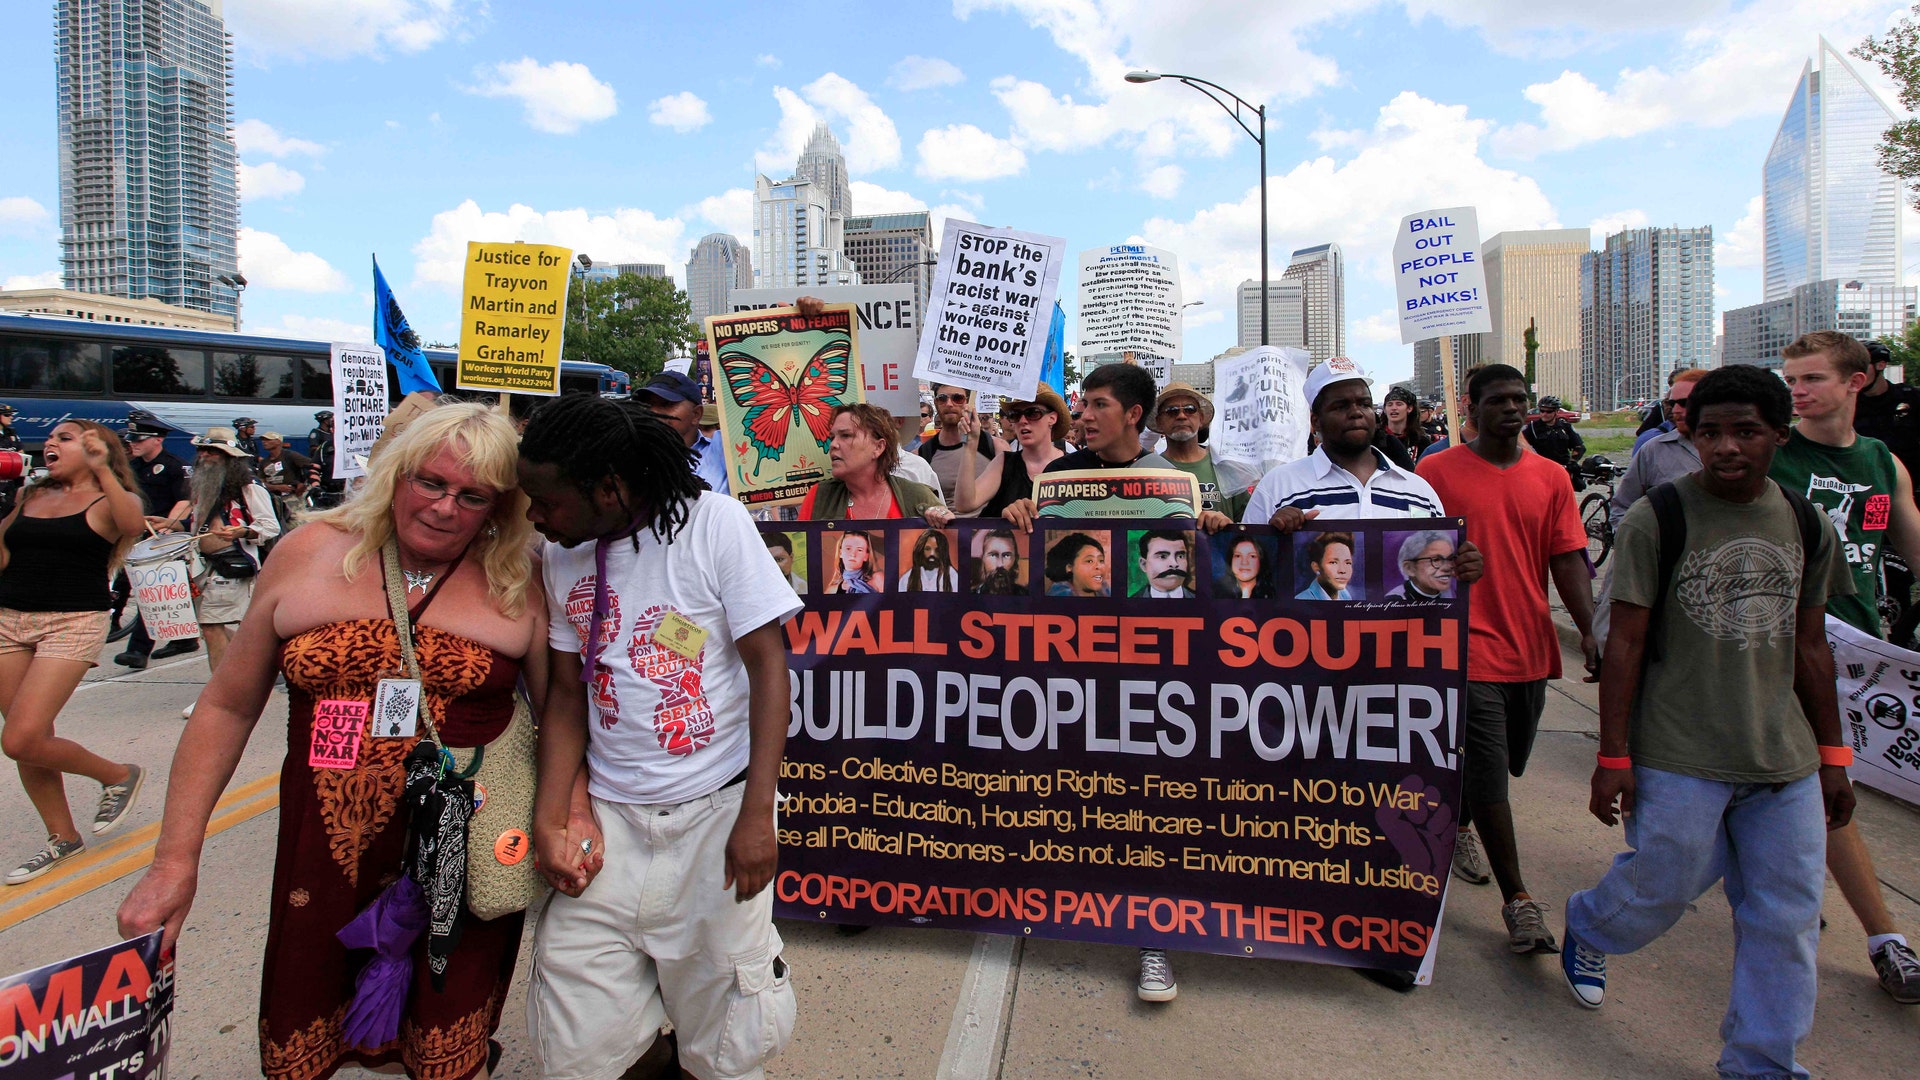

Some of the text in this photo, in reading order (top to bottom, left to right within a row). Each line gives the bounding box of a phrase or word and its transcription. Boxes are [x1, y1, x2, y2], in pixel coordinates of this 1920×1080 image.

[960, 234, 1043, 263] STOP the
[1110, 245, 1146, 254] PERMIT
[1415, 234, 1454, 250] OUT
[475, 249, 561, 266] Justice for
[1100, 255, 1151, 263] Amendment
[1401, 252, 1475, 274] PEOPLE
[956, 253, 1038, 287] bank's
[1419, 272, 1459, 288] NOT
[485, 273, 548, 293] Trayvon
[949, 281, 1040, 309] racist war
[1406, 287, 1478, 311] BANKS!
[470, 296, 557, 315] Martin and
[972, 303, 1030, 323] against
[475, 321, 550, 343] Ramarley
[715, 313, 849, 338] NO PAPERS NO FEAR!!!
[945, 311, 1026, 337] workers &
[939, 324, 1027, 357] the poor!
[1082, 336, 1128, 346] Government
[388, 349, 414, 368] FEAR
[477, 345, 544, 364] Graham!
[937, 346, 1021, 370] Coalition to March on
[465, 363, 552, 379] Workers World Party
[944, 357, 1012, 377] Wall Street South
[463, 375, 505, 386] workers.org
[1040, 481, 1190, 499] NO PAPERS NO FEAR!!!
[1813, 478, 1856, 492] SOLIDARITY
[740, 495, 750, 503] EL
[750, 492, 774, 502] MIEDO
[774, 490, 785, 499] SE
[1866, 503, 1890, 511] OUT
[1866, 510, 1888, 519] NOT
[1865, 517, 1886, 525] WAR
[168, 612, 180, 620] IS
[176, 601, 191, 611] ON
[784, 608, 1459, 671] WALL STREET SOUTH
[635, 646, 653, 657] ON
[647, 658, 700, 678] SOUTH
[594, 673, 612, 701] 2
[318, 704, 365, 717] MAKE
[660, 698, 704, 724] SEPT
[787, 668, 1458, 770] BUILD PEOPLES POWER!
[317, 716, 362, 731] OUT
[688, 720, 711, 734] 2012
[314, 729, 359, 746] NOT
[1850, 721, 1862, 754] Energy
[1858, 724, 1869, 748] Duke
[313, 744, 354, 760] WAR
[1882, 727, 1920, 769] coal
[841, 757, 937, 785] Collective
[941, 763, 1051, 797] Bargaining
[1056, 769, 1126, 798] Rights
[1144, 774, 1197, 800] Free
[1200, 777, 1275, 802] Tuition
[1293, 779, 1336, 804] NO
[1341, 782, 1365, 807] to
[1368, 782, 1424, 812] War
[873, 793, 977, 828] Education,
[982, 804, 1076, 833] Housing,
[1082, 806, 1202, 836] Healthcare
[1220, 814, 1289, 840] Union
[1294, 816, 1371, 849] Rights
[777, 826, 1440, 896] ee all Political Prisoners Jobs not Jails Environmental Justice
[776, 870, 1048, 922] CORPORATIONS
[1054, 889, 1123, 928] PAY
[1127, 895, 1207, 936] FOR
[1211, 902, 1327, 947] THEIR
[0, 1024, 46, 1068] ON
[52, 993, 141, 1046] WALL
[67, 1036, 106, 1064] in the
